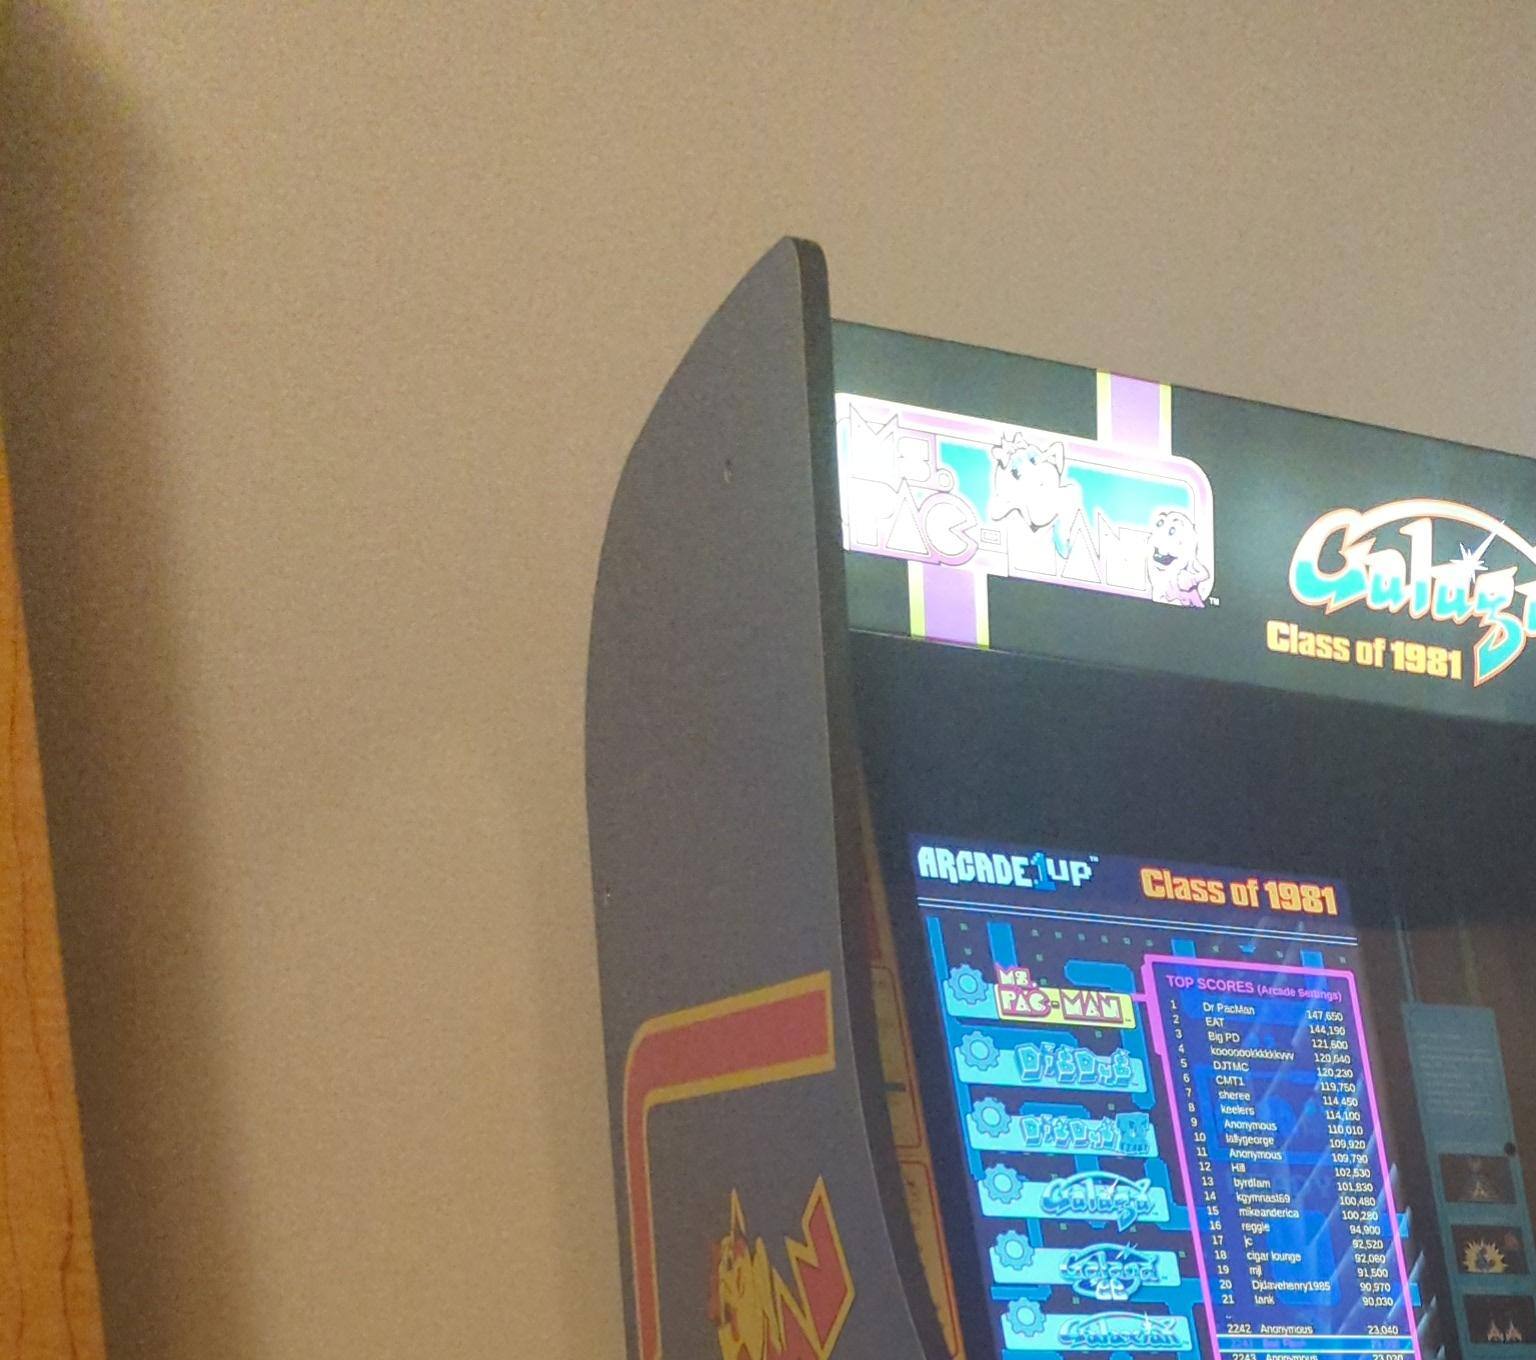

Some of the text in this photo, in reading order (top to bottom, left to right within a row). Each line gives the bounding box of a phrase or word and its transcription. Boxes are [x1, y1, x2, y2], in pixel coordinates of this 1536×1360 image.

[1266, 619, 1462, 680] Class of 1981
[1140, 868, 1338, 915] Class of 1981
[1166, 975, 1342, 1002] TOP SCORES (Arcade Settings)
[999, 986, 1124, 1024] PAC-MAN
[1170, 1000, 1344, 1022] 1 Dr PacMan 147,650
[1172, 1014, 1346, 1036] 2 EAT 144,190
[1175, 1029, 1182, 1038] 3
[1208, 1031, 1223, 1044] Big
[1225, 1032, 1240, 1043] PD
[1177, 1043, 1185, 1053] 4
[1180, 1058, 1354, 1079] 5 DJTMC 120,230
[1183, 1073, 1190, 1082] 6
[1185, 1087, 1192, 1097] 7
[1188, 1102, 1195, 1112] 8
[1326, 1110, 1361, 1122] 114,100
[1190, 1117, 1364, 1136] 9 Anonymous 110,010
[1194, 1131, 1206, 1141] 10
[1197, 1146, 1208, 1156] 11
[1229, 1148, 1283, 1162] Anonymous
[1199, 1161, 1212, 1171] 12
[1334, 1167, 1371, 1179] 102,530
[1202, 1176, 1214, 1186] 13
[1204, 1191, 1216, 1201] 14
[1339, 1196, 1376, 1207] 100,480
[1206, 1206, 1219, 1216] 15
[1209, 1221, 1381, 1236] 16 reggie 94,900
[1211, 1236, 1223, 1245] 17
[1352, 1239, 1384, 1250] 92,520
[1214, 1250, 1227, 1260] 18
[1246, 1251, 1269, 1263] cigar
[1271, 1251, 1301, 1264] lounge
[1217, 1265, 1229, 1275] 19
[1357, 1267, 1389, 1279] 91,500
[1219, 1280, 1232, 1289] 20
[1221, 1295, 1235, 1304] 21
[1362, 1296, 1394, 1308] 90,030
[1227, 1324, 1252, 1334] 2242
[1259, 1325, 1313, 1336] Anonymous
